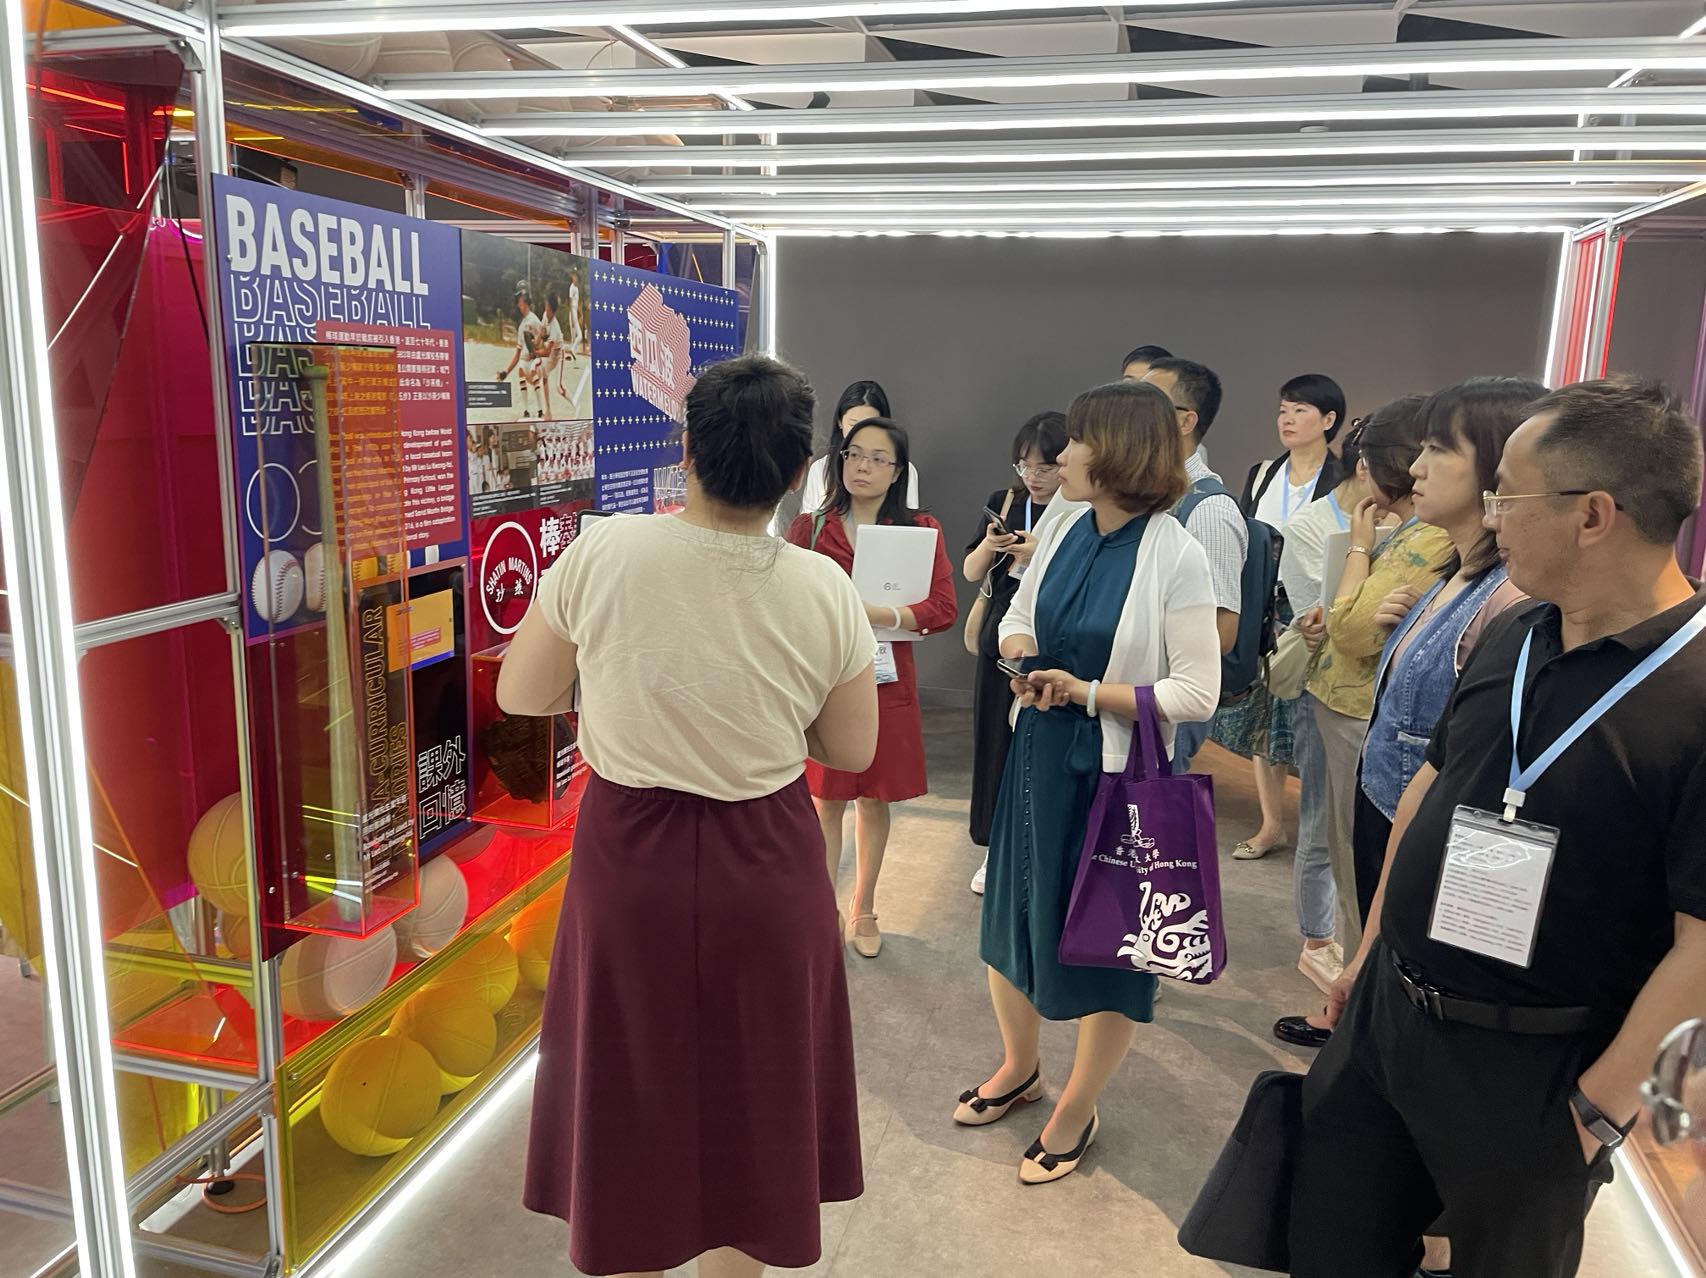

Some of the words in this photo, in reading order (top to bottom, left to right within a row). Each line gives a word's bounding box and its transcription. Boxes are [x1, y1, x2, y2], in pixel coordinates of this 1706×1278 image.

[226, 194, 429, 296] BASEBALL
[231, 274, 431, 330] BASEBALL
[539, 516, 559, 558] 棒
[486, 560, 506, 595] SHATIN
[508, 557, 533, 585] MARTINS
[417, 735, 466, 794] 課外
[418, 778, 467, 840] 回憶
[1099, 854, 1128, 867] Chinese
[1154, 860, 1174, 870] Hong
[1176, 859, 1197, 870] Kong
